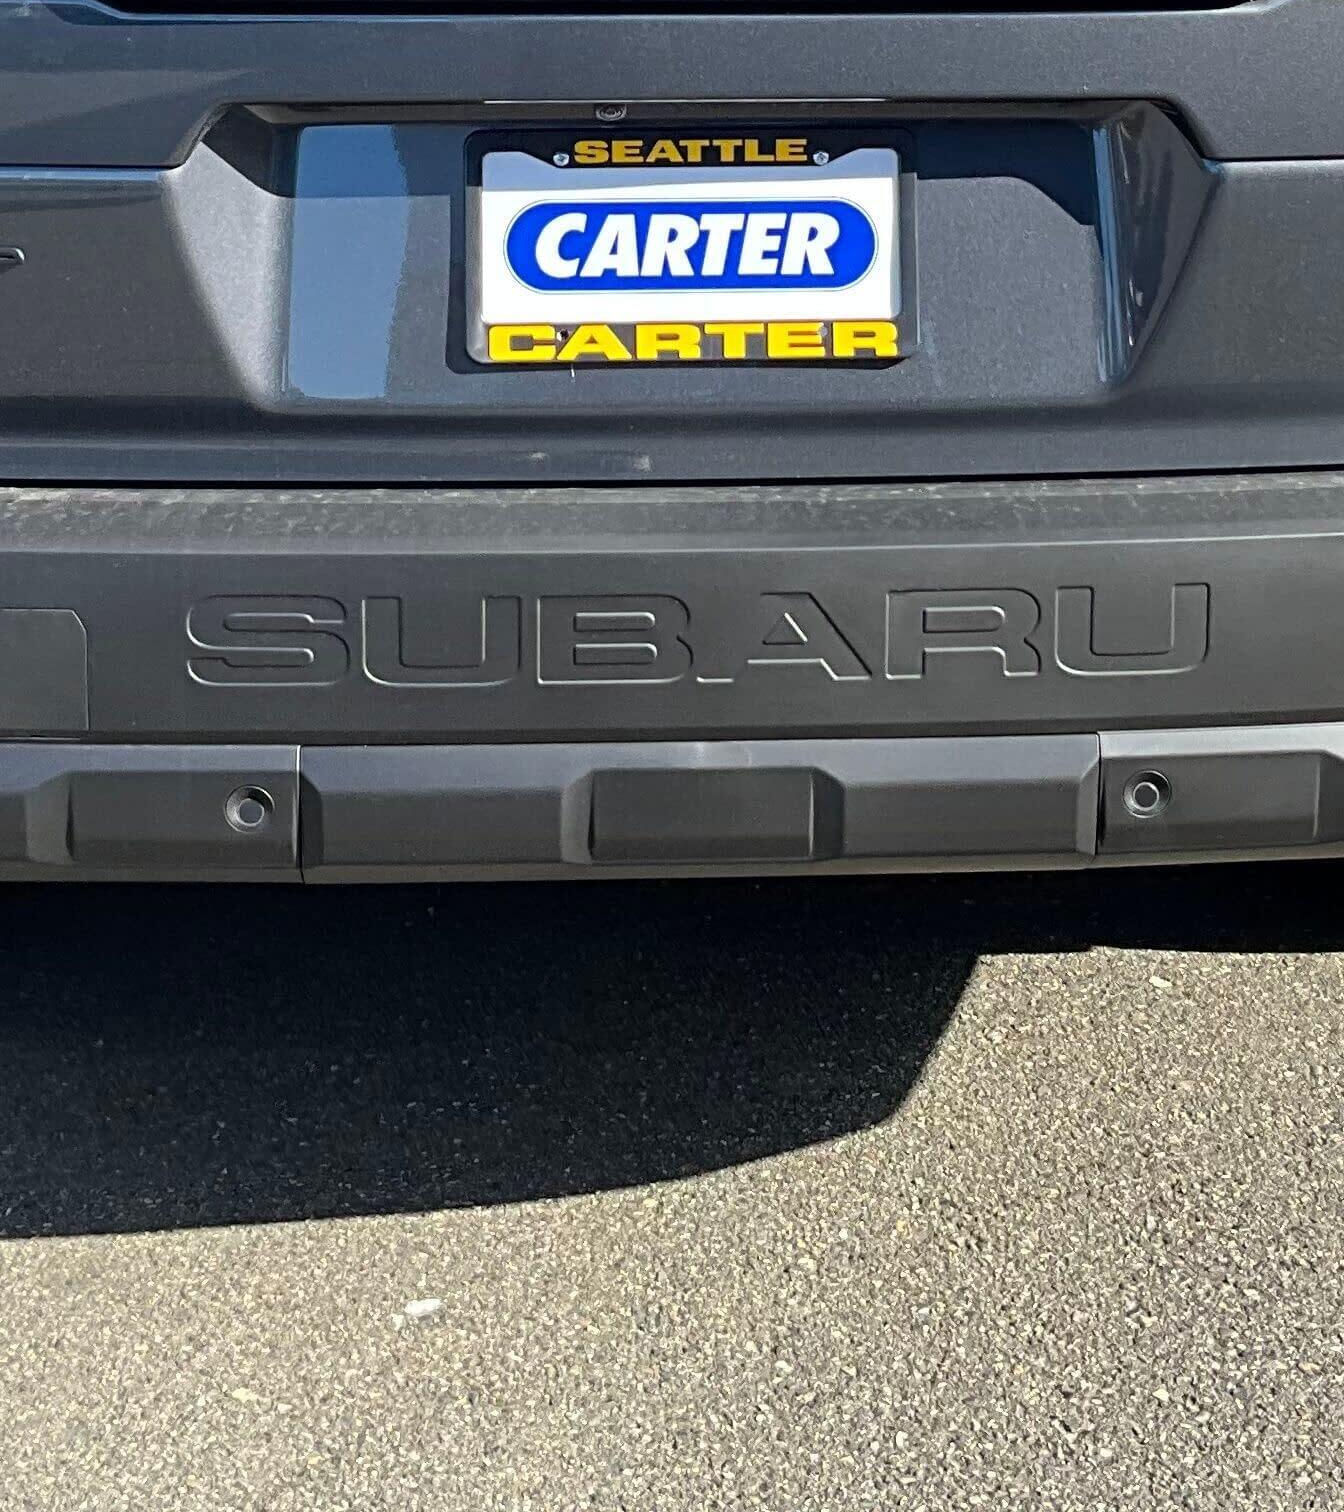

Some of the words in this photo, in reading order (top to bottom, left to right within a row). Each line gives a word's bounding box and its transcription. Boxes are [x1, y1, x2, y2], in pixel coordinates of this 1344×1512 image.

[573, 138, 808, 164] SEATTLE
[534, 212, 840, 278] CARTER
[488, 321, 899, 362] CARTER
[187, 582, 1210, 686] SUBARU
